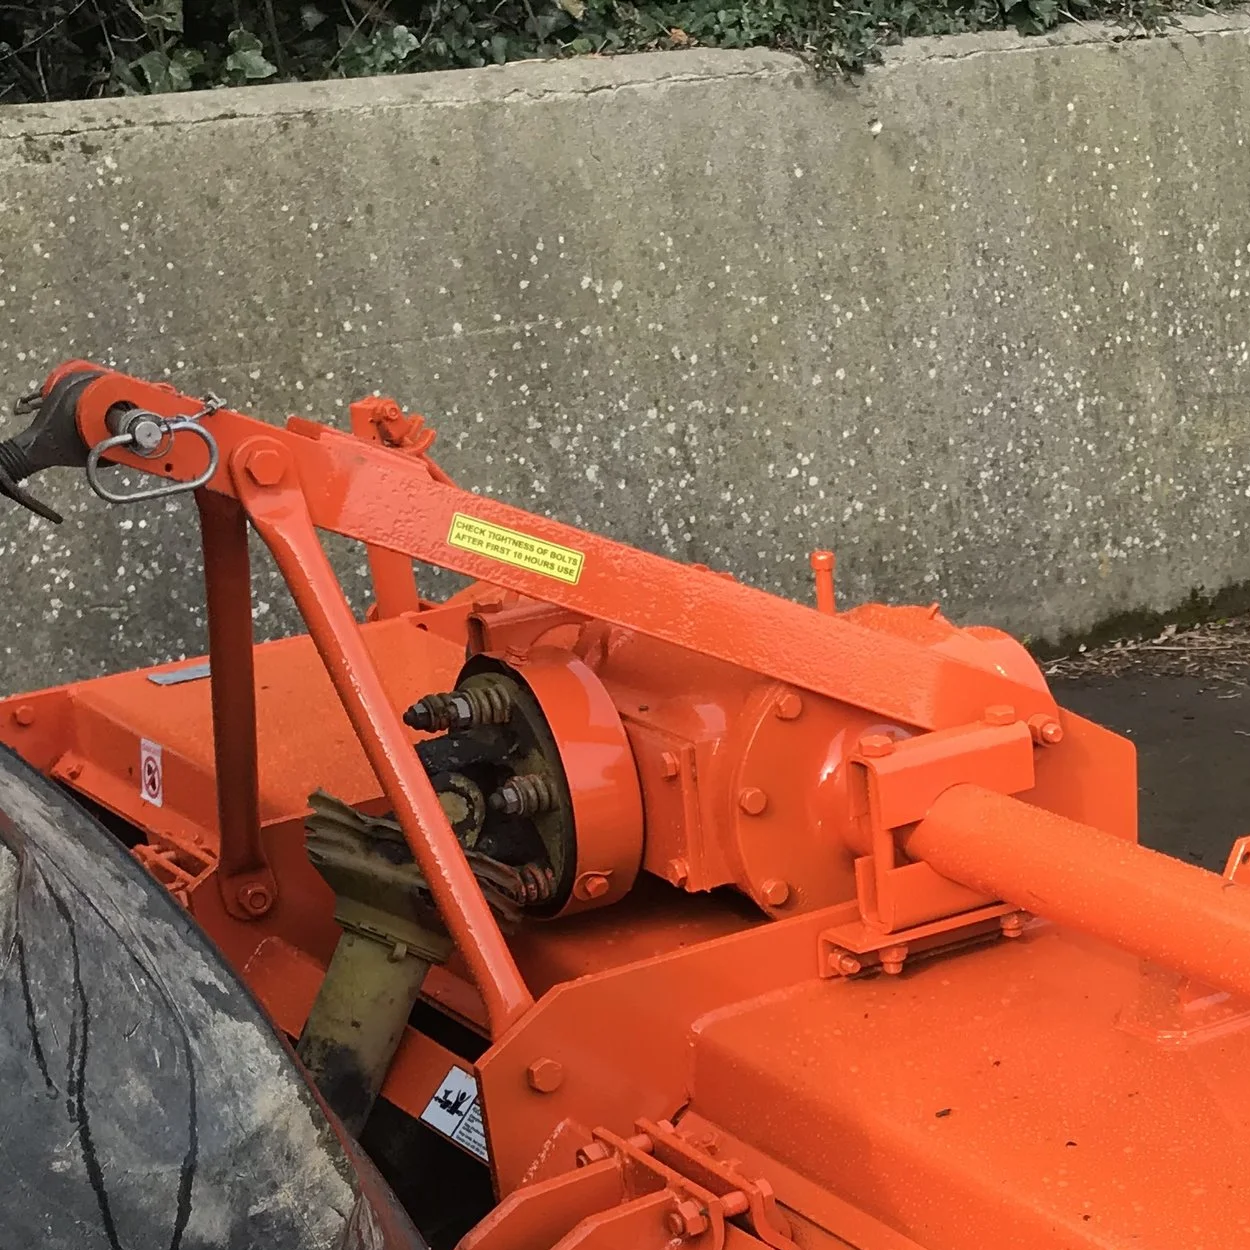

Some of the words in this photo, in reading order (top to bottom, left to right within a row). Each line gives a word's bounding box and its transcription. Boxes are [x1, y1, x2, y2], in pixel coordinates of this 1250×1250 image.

[454, 532, 484, 547] AFTER
[485, 542, 511, 556] FIRST
[524, 554, 555, 571] HOURS
[557, 565, 575, 577] USE
[455, 521, 487, 536] CHECK
[488, 530, 535, 552] TIGHTNESS
[536, 547, 549, 556] OF
[550, 551, 578, 566] BOLTS
